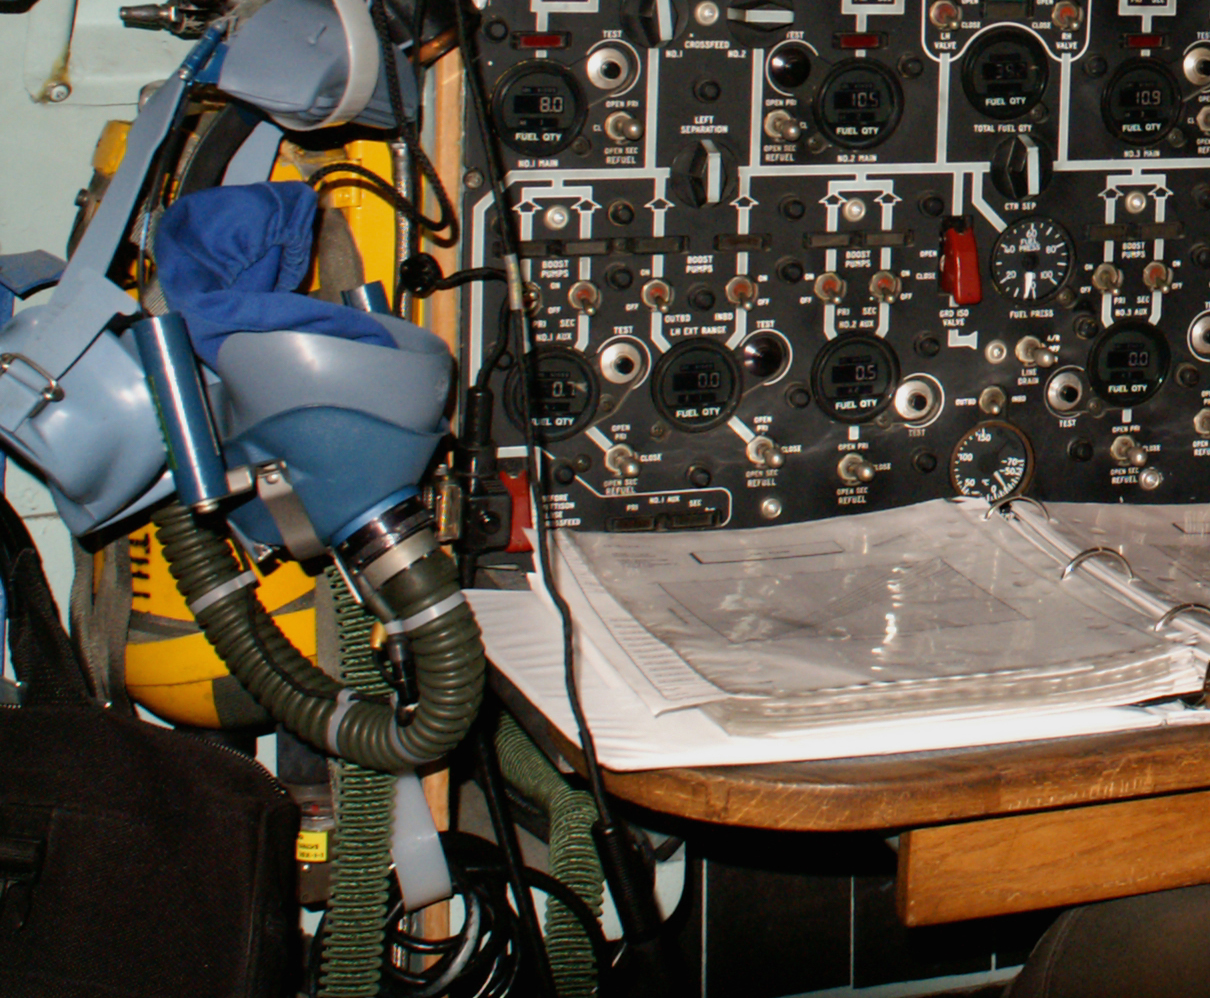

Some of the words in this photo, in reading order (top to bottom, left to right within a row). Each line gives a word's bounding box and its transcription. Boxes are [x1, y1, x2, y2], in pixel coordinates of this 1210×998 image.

[603, 30, 622, 38] TEST
[680, 125, 728, 134] SEPARATION
[974, 125, 994, 133] TOTAL
[997, 125, 1016, 133] FUEL
[1018, 125, 1032, 133] QTY
[515, 133, 539, 142] FUEL
[543, 133, 562, 142] QTY
[606, 156, 636, 164] REFUEL
[1031, 309, 1054, 318] PRESS
[682, 327, 698, 335] EXT
